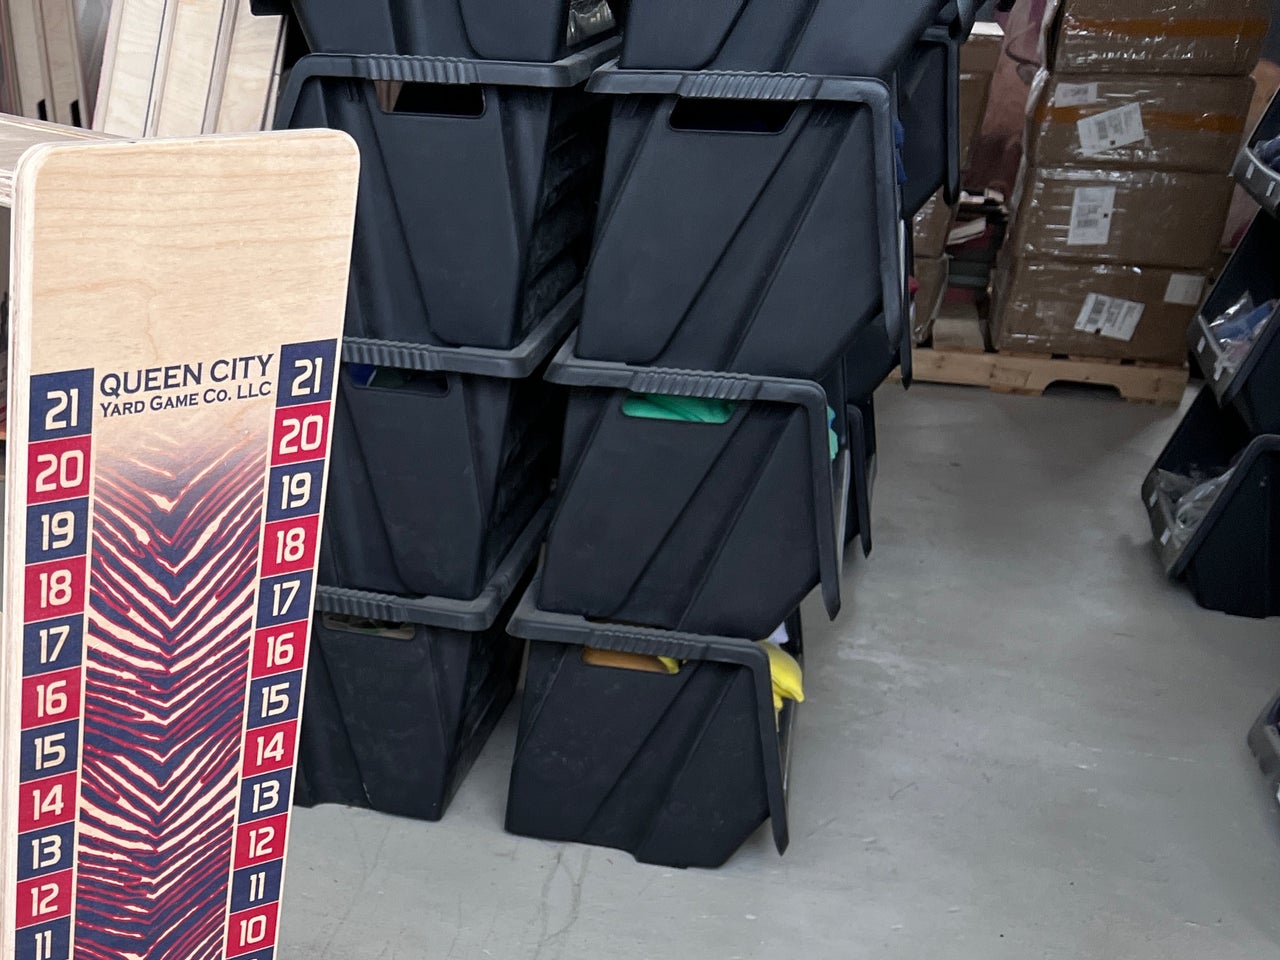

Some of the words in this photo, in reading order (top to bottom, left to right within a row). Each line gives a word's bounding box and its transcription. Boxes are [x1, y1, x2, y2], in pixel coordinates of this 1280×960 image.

[100, 361, 202, 398] QUEEN
[209, 353, 275, 384] CITY
[291, 356, 323, 397] 21
[44, 387, 79, 431] 21
[100, 399, 146, 418] YARD
[149, 392, 199, 411] GAME
[237, 381, 272, 399] LLC
[279, 414, 324, 455] 20
[35, 449, 84, 493] 20
[281, 471, 312, 510] 19
[40, 510, 75, 551] 19
[275, 527, 306, 564] 18
[39, 569, 72, 609] 18
[272, 579, 301, 617] 17
[39, 624, 71, 664] 17
[266, 631, 294, 668] 16
[36, 679, 68, 718] 16
[260, 681, 290, 718] 15
[34, 732, 66, 771] 15
[256, 731, 285, 766] 14
[32, 783, 65, 821] 14
[252, 779, 280, 814] 13
[31, 834, 62, 870] 13
[248, 826, 275, 859] 12
[30, 882, 60, 917] 12
[249, 871, 266, 902] 11
[239, 914, 267, 947] 10
